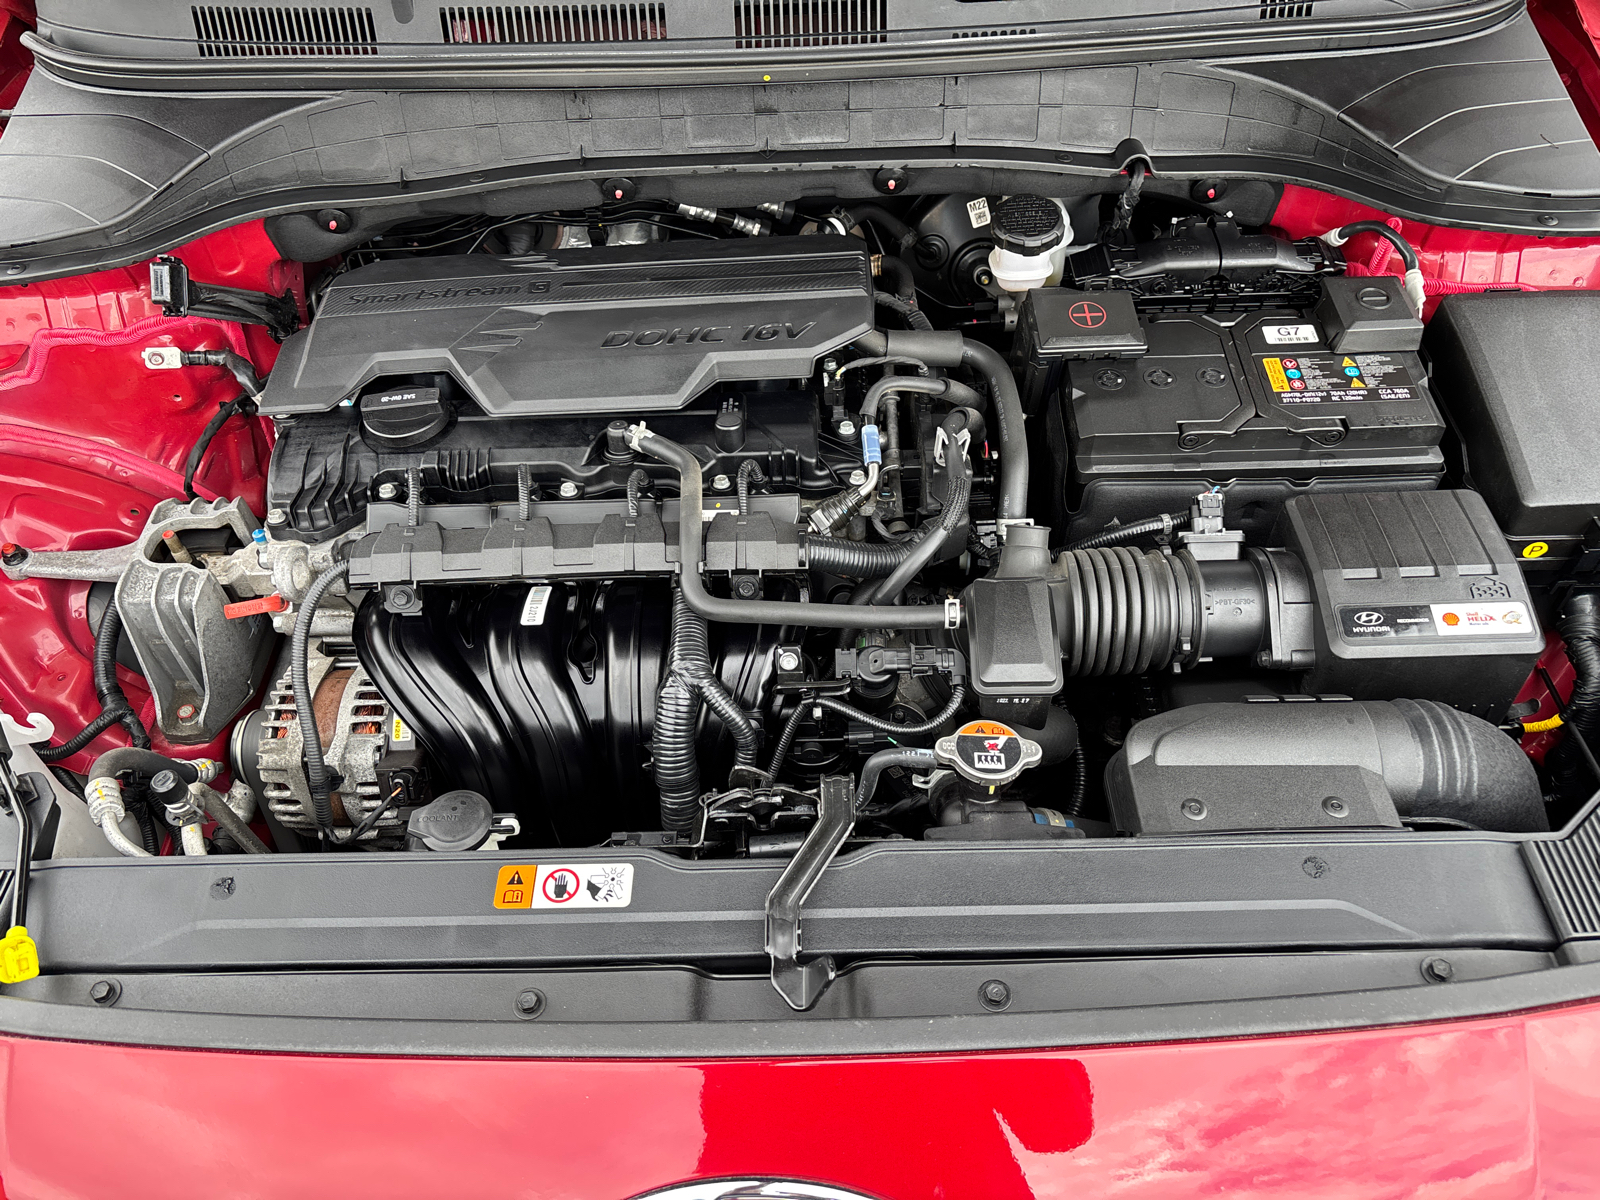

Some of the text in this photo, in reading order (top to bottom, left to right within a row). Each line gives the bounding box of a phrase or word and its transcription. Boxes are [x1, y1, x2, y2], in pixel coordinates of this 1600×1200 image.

[968, 198, 988, 213] M22
[346, 284, 522, 305] Smartstream
[600, 321, 818, 350] DOHC 16V
[1277, 326, 1300, 337] G7
[1528, 545, 1543, 556] P
[1352, 625, 1391, 633] HYUNDAI
[417, 813, 460, 823] COOLANT
